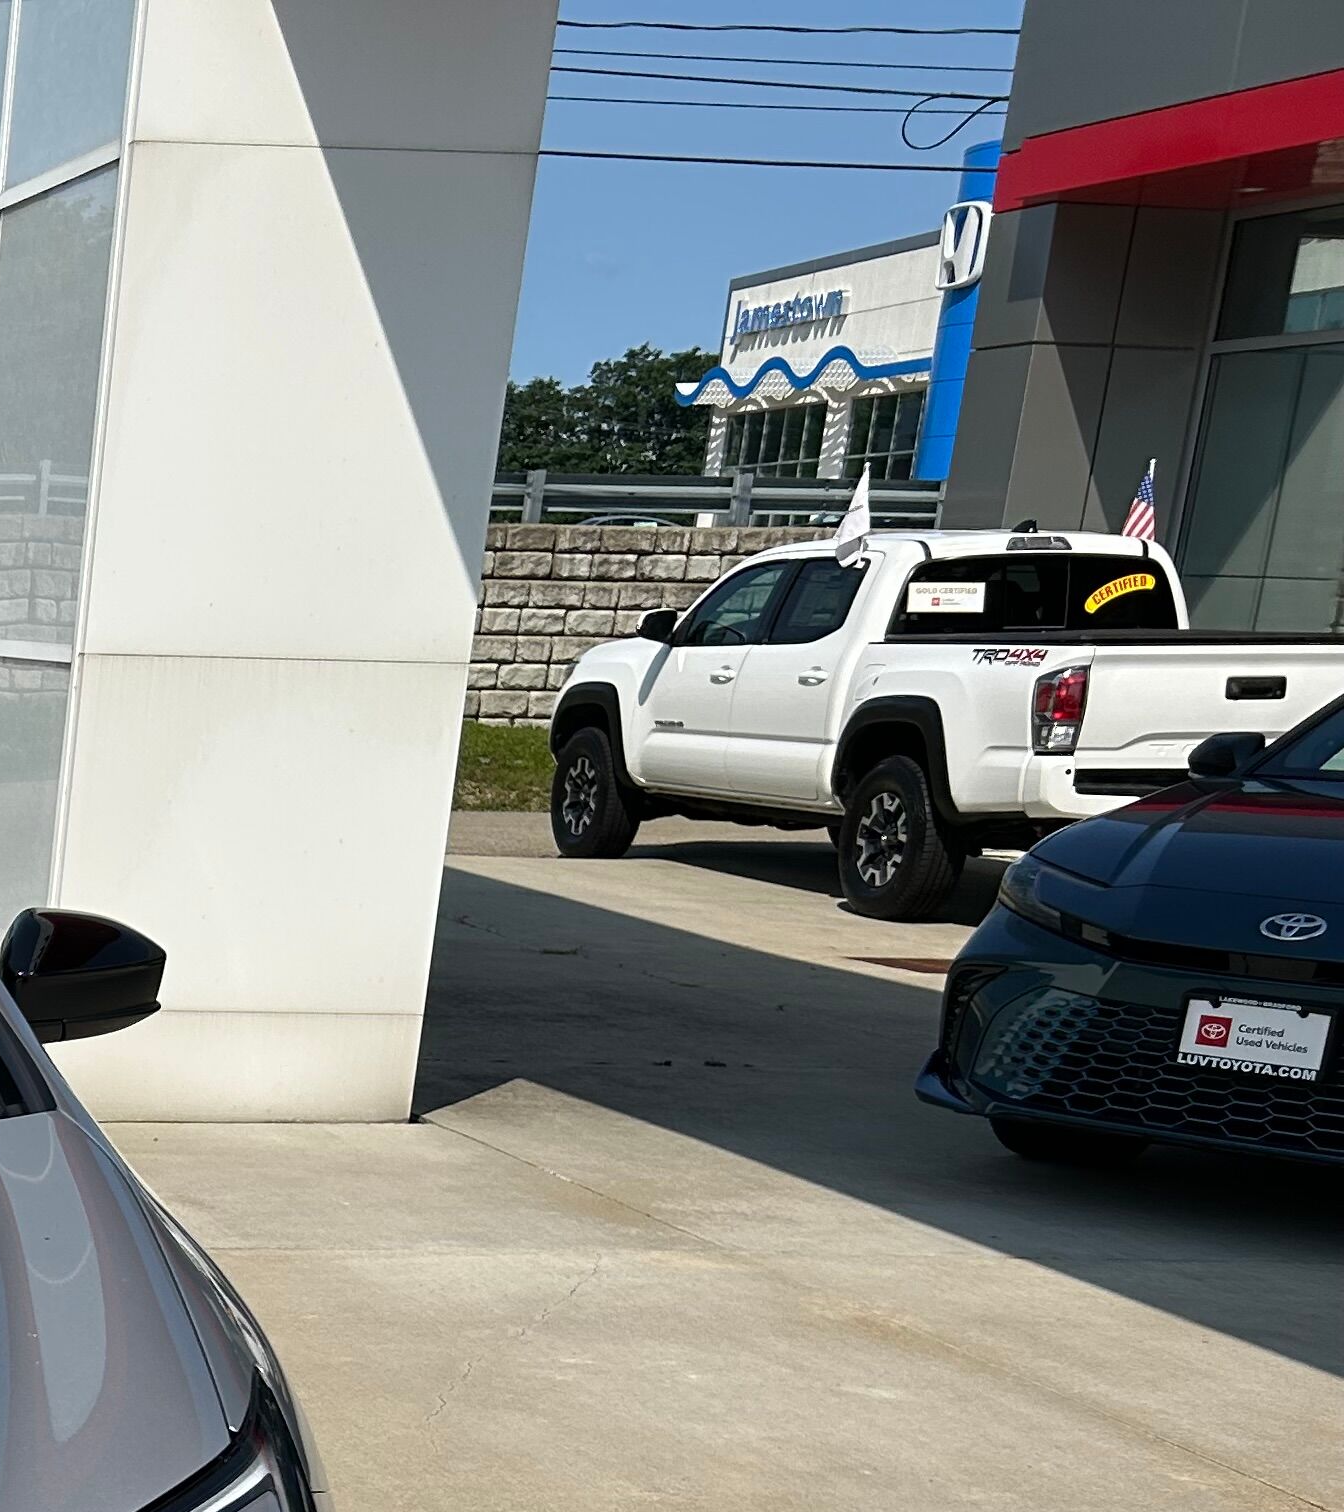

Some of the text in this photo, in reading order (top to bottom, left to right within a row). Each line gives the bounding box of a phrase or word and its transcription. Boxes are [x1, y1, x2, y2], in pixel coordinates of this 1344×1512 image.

[729, 290, 843, 346] Jamestown
[1092, 575, 1147, 604] CERTIFIED
[1236, 1036, 1308, 1054] Used Vehicles
[1238, 1023, 1285, 1038] Certified
[1176, 1052, 1317, 1081] LUVTOYOTA.COM
